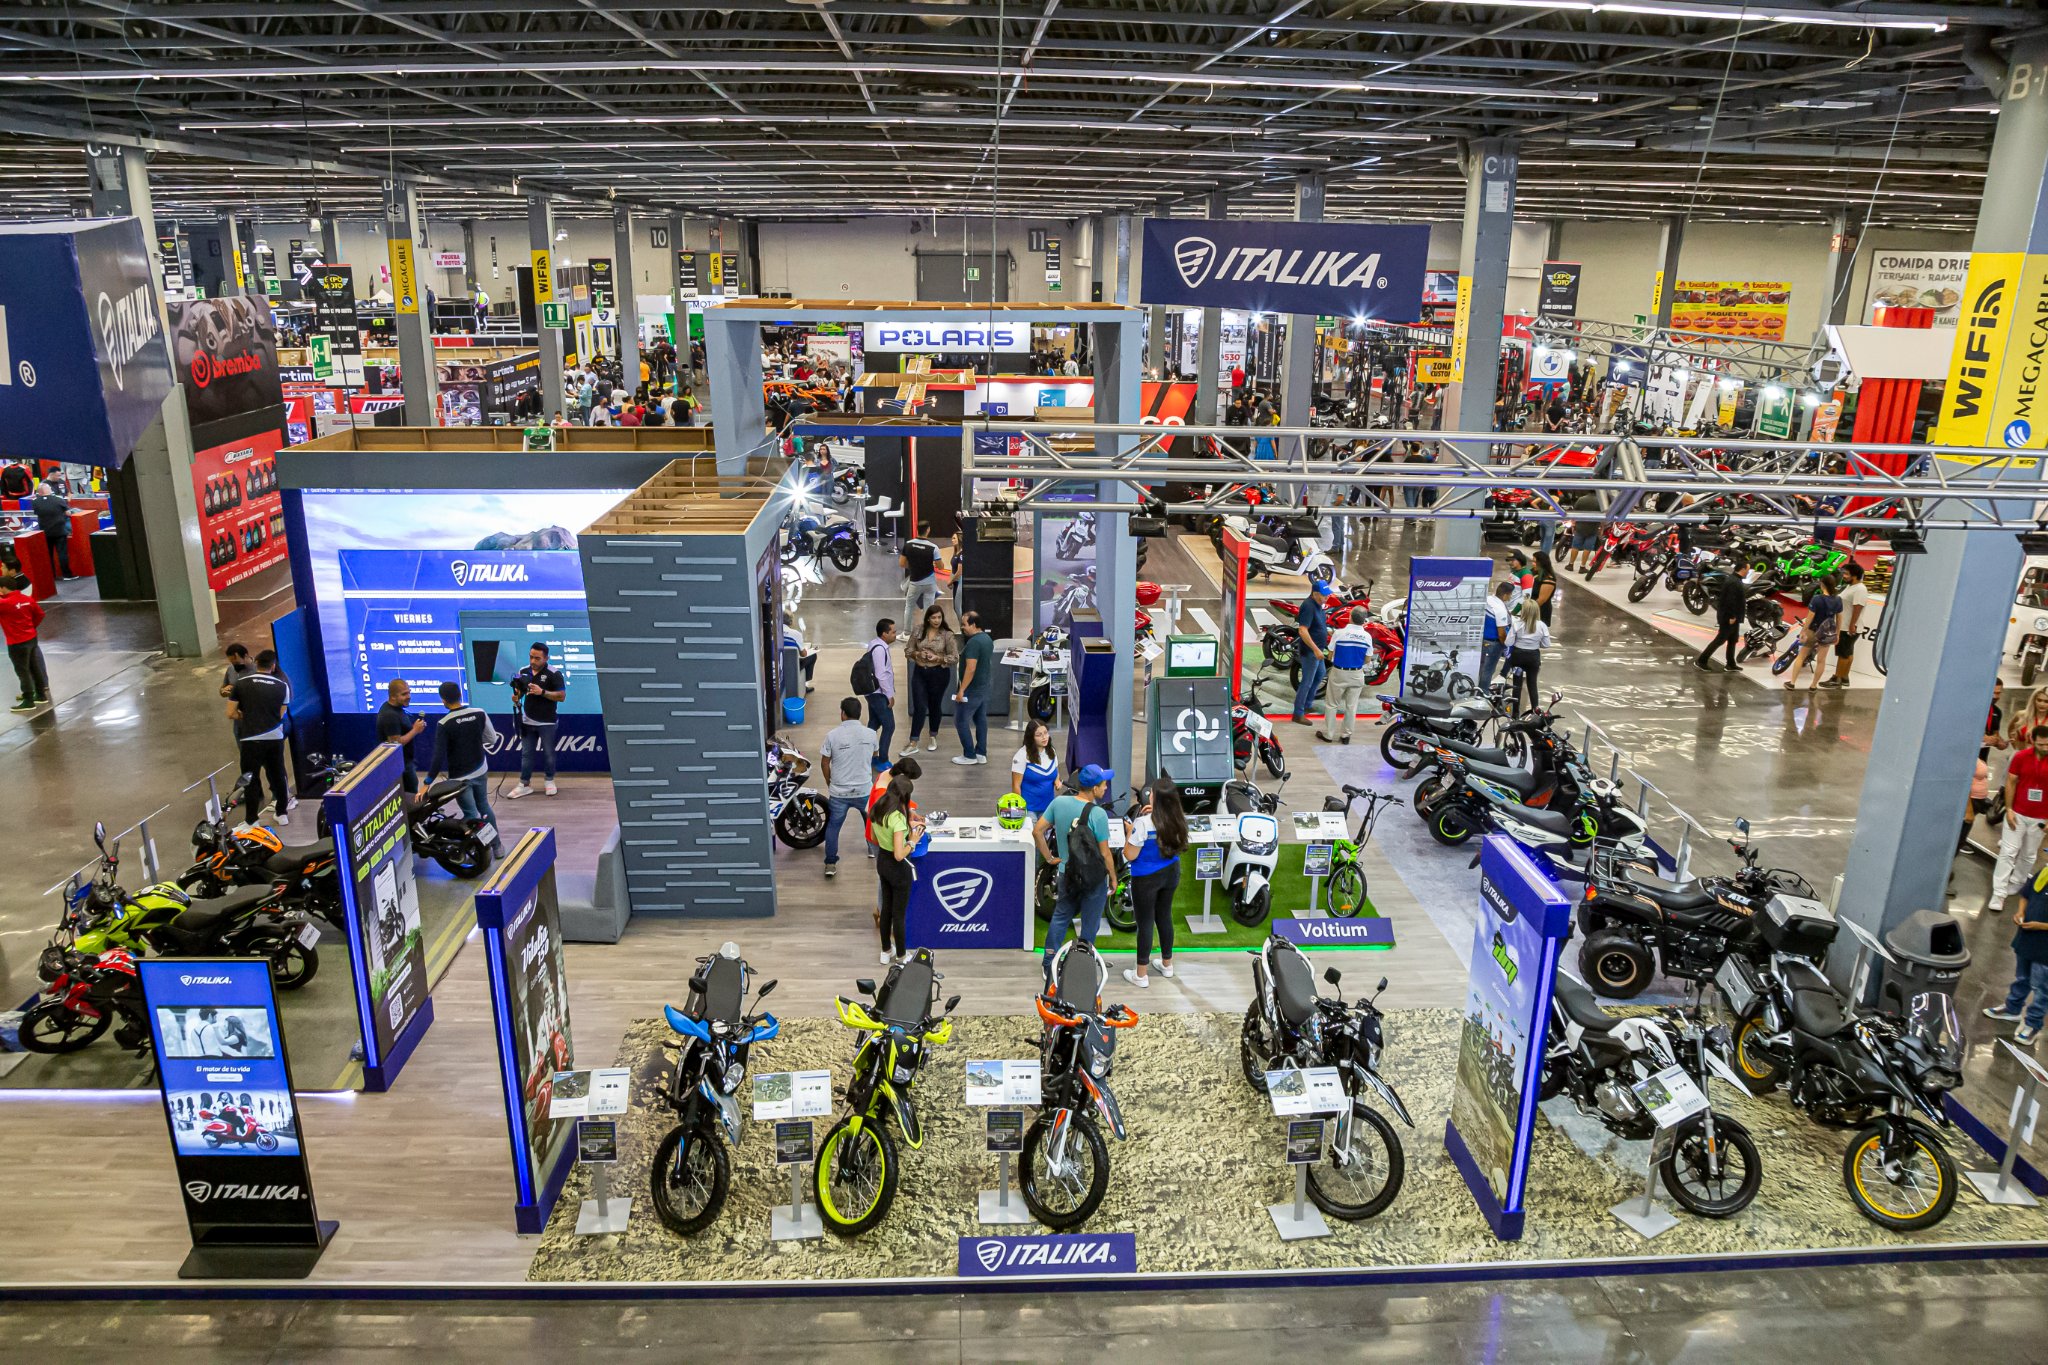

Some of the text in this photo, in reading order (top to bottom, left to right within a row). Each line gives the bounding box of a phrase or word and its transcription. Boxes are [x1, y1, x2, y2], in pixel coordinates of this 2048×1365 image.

[652, 229, 668, 247] 10
[1030, 230, 1045, 250] 11
[399, 245, 411, 297] MEGACABLE
[1215, 247, 1381, 288] ITALIKA
[1880, 257, 1934, 269] COMIDA
[1877, 271, 1963, 282] TERIYAKI RAMEN
[115, 284, 158, 366] ITALIKA
[879, 330, 1014, 346] POLARIS
[1224, 353, 1241, 361] 530
[212, 352, 262, 379] brembo
[1432, 362, 1451, 370] ZONA
[1952, 316, 1998, 418] WiFi
[468, 564, 526, 582] ITALIKA
[1423, 580, 1451, 588] ITALIKA
[394, 614, 433, 624] VIERNES
[1425, 615, 1470, 624] FT150
[364, 795, 402, 842] ITALIKA+
[1487, 885, 1510, 916] ITALIKA
[939, 923, 987, 933] ITALIKA
[1299, 922, 1368, 938] Voltium
[191, 976, 230, 985] ITALIKA
[237, 1065, 251, 1073] vida
[213, 1184, 300, 1200] ITALIKA
[1006, 1242, 1111, 1266] ITALIKA
